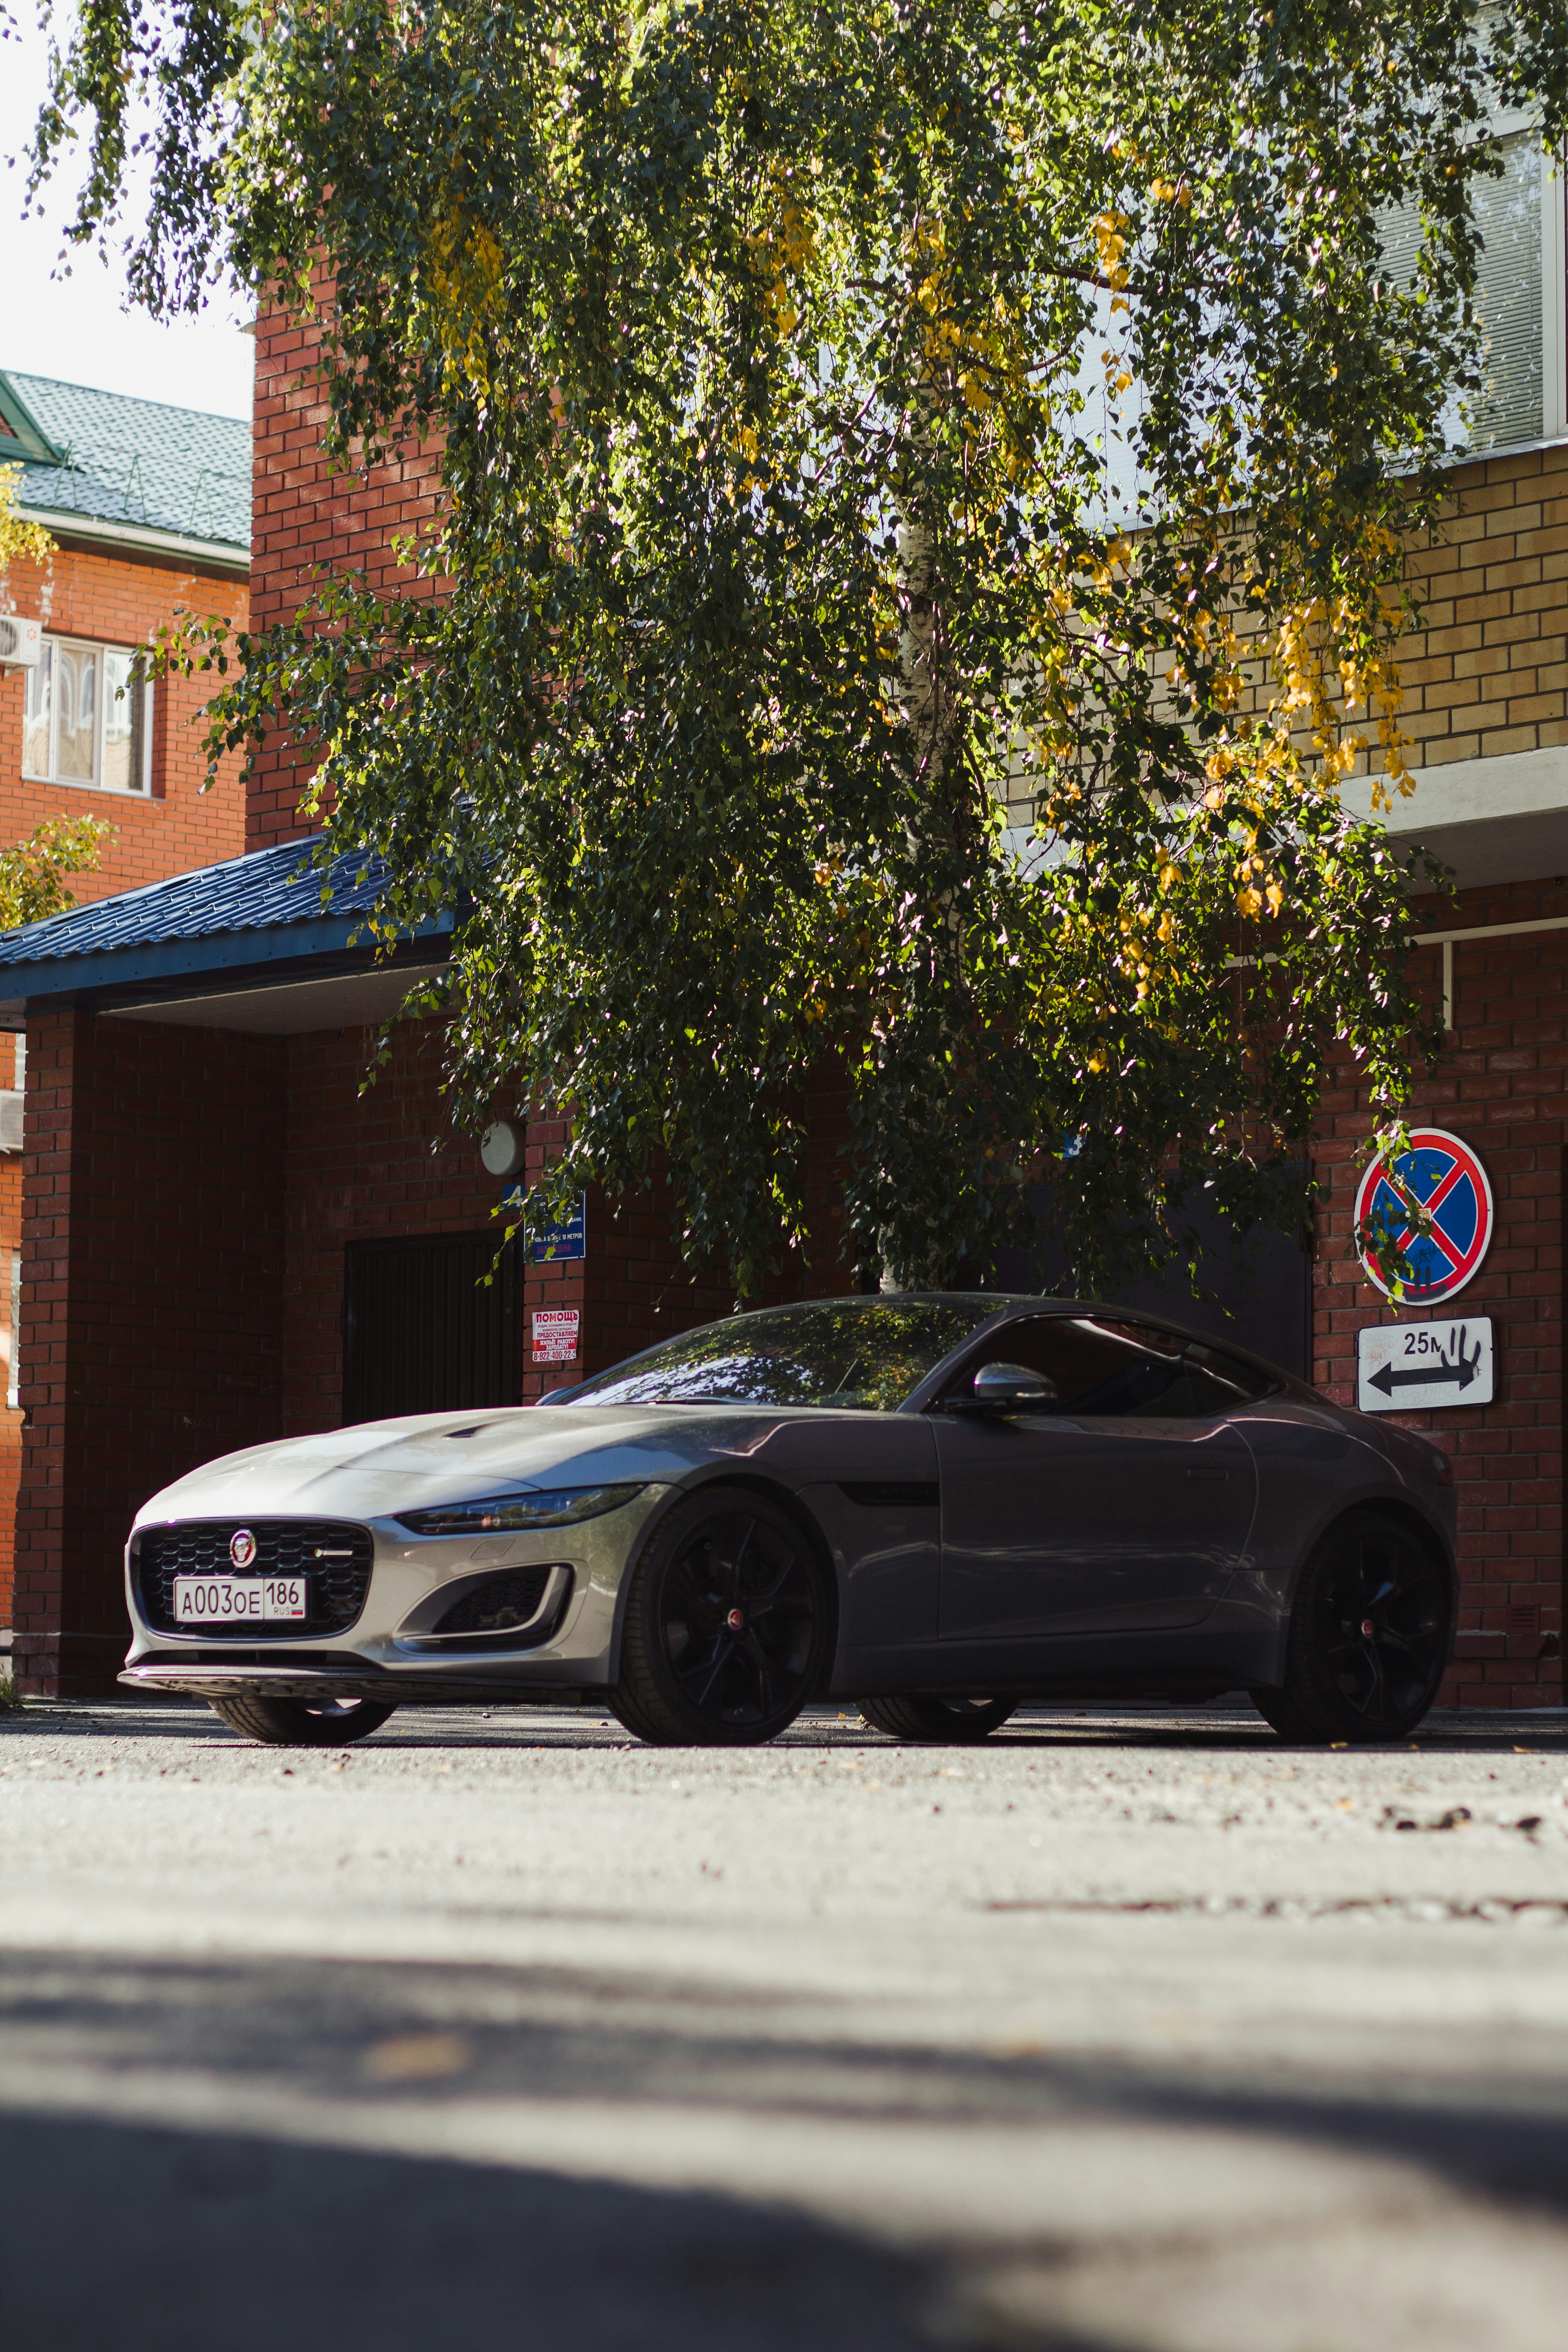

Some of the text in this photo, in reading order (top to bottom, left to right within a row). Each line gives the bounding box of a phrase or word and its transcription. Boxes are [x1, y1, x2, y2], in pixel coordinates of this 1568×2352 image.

[1069, 1135, 1083, 1156] 3
[509, 1185, 523, 1207] 4
[537, 1244, 571, 1254] ЗАПЩЕНА
[536, 1312, 578, 1323] ПОМОЩЬ
[266, 1582, 299, 1605] 186
[274, 1607, 290, 1615] RUS
